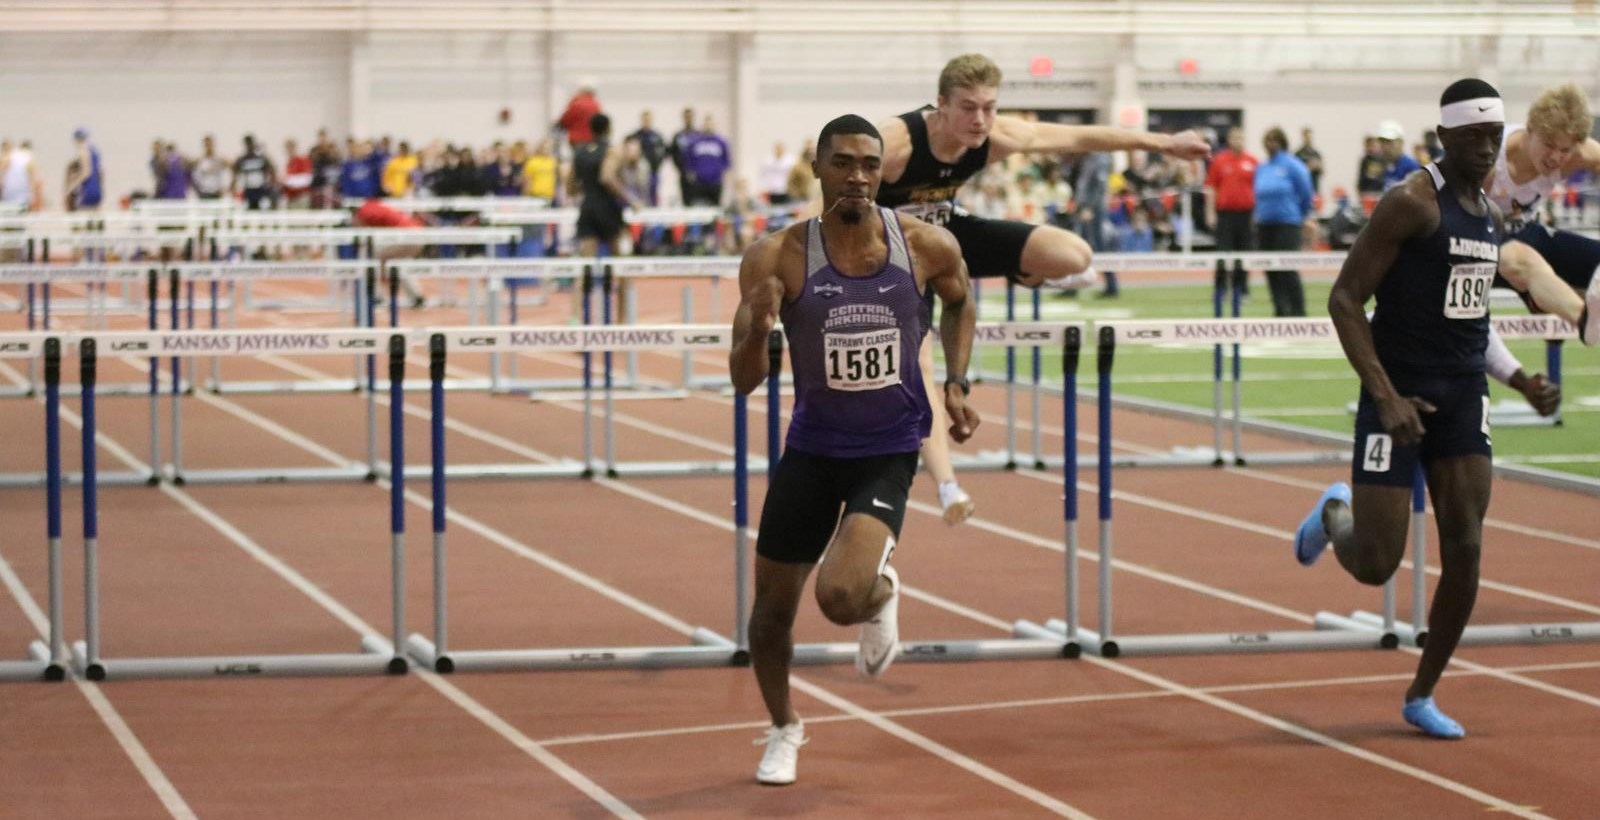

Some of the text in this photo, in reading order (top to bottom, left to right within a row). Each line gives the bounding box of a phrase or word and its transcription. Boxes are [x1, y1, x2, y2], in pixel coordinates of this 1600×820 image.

[829, 304, 894, 318] CENTRAL
[825, 314, 897, 328] ARKANSAS
[1497, 320, 1547, 333] ANSAS
[460, 331, 720, 346] UCS KANSAS JAYHAWKS UCS
[1015, 331, 1051, 340] UCS
[1127, 323, 1330, 339] UCS KANSAS JAYHAWKS
[0, 342, 29, 351] CS
[111, 335, 376, 352] UCS KANSAS JAYHAWKS UCS
[828, 331, 897, 347] JAYHAWK CLASSIC
[829, 345, 896, 381] 1581
[1368, 437, 1384, 468] 4
